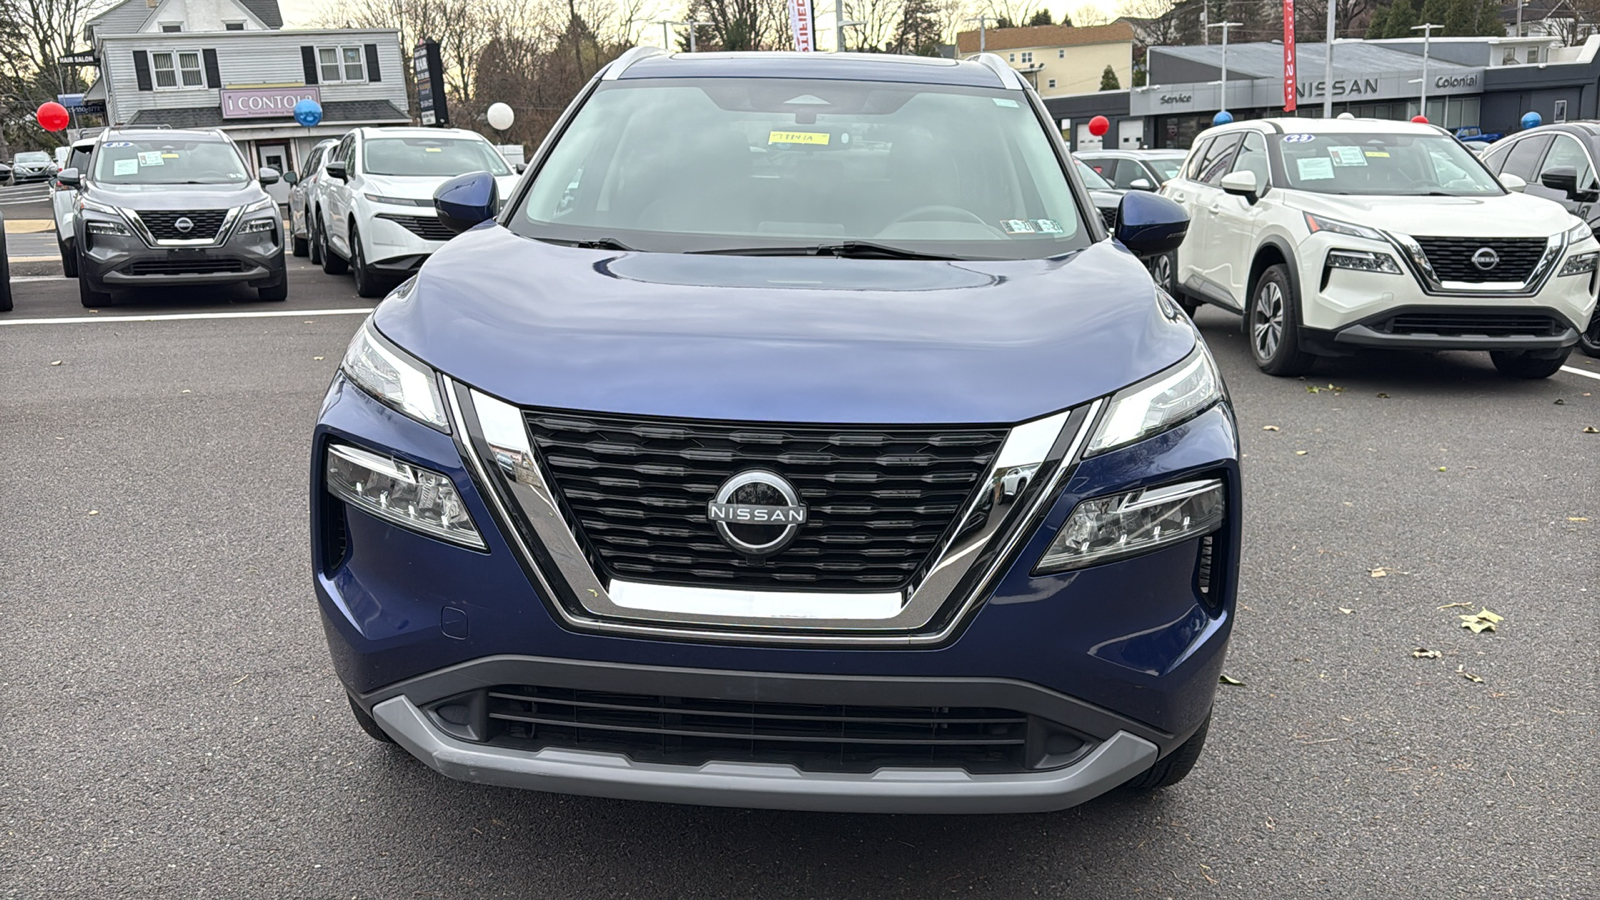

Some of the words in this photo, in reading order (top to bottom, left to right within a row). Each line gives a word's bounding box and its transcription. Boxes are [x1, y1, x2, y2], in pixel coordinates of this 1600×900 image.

[1296, 78, 1379, 98] NISSAN
[1435, 75, 1478, 89] Colonial
[1160, 93, 1192, 105] Service
[711, 506, 803, 521] NISSAN
